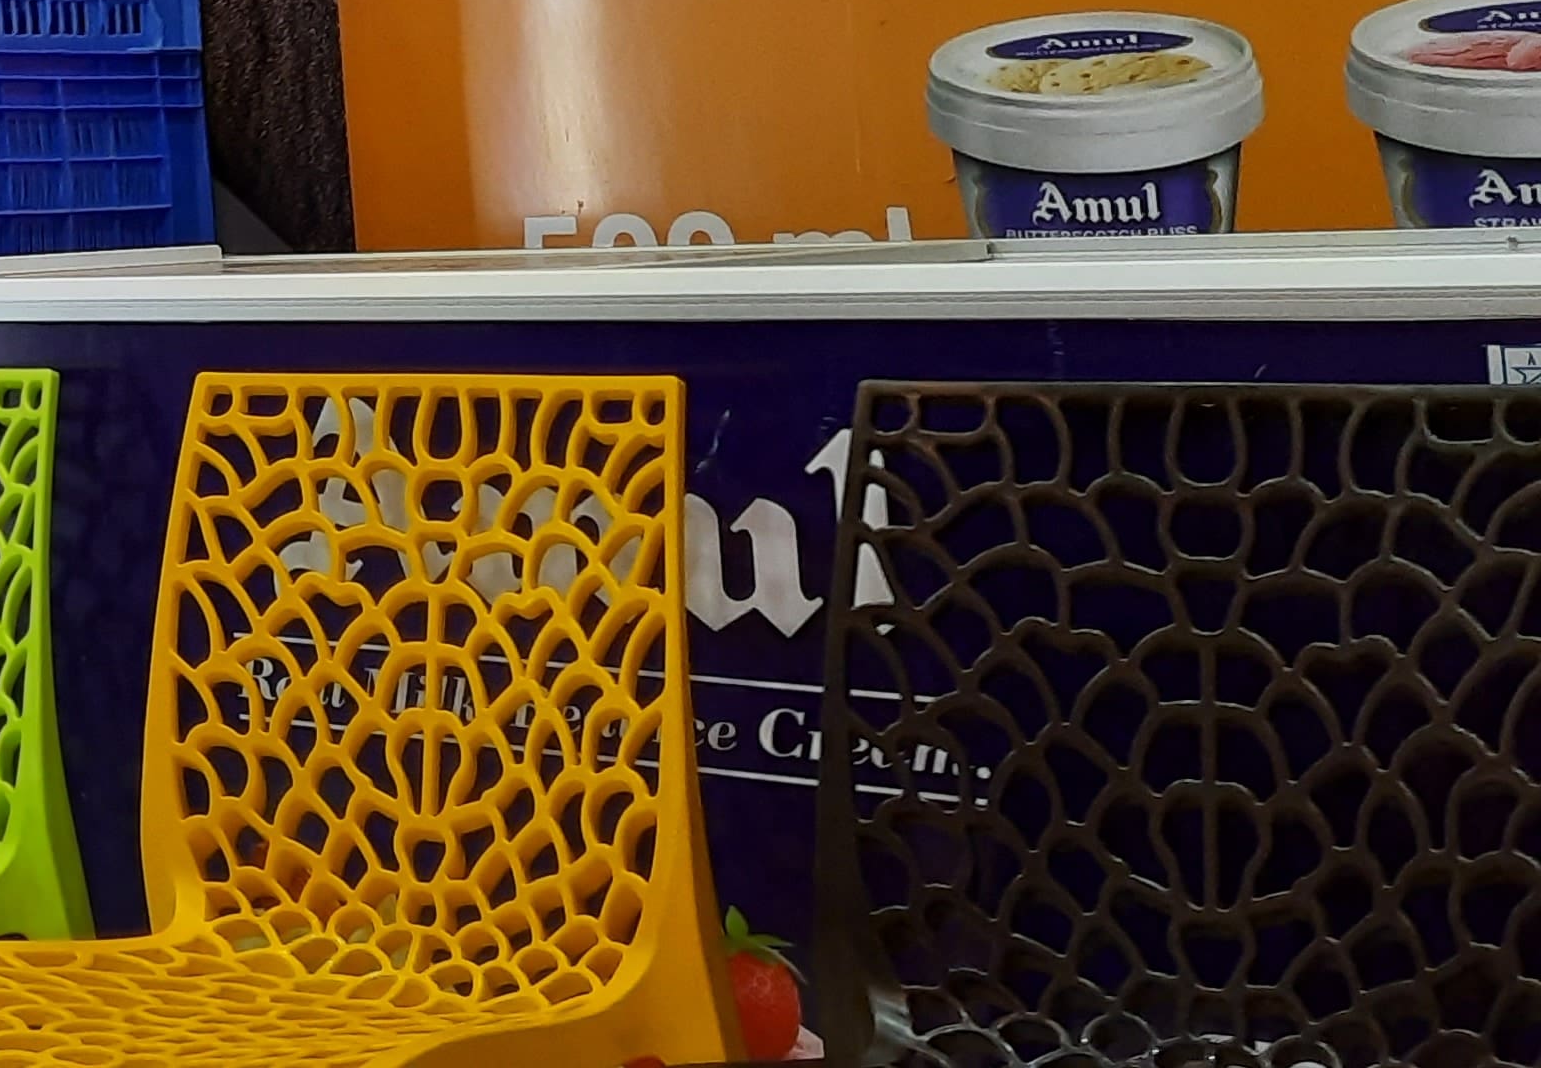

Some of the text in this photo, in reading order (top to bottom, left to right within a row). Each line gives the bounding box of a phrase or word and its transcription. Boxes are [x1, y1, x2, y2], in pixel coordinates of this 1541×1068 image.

[1037, 34, 1139, 51] Amul
[1032, 180, 1162, 227] Amul
[1468, 168, 1541, 210] Am
